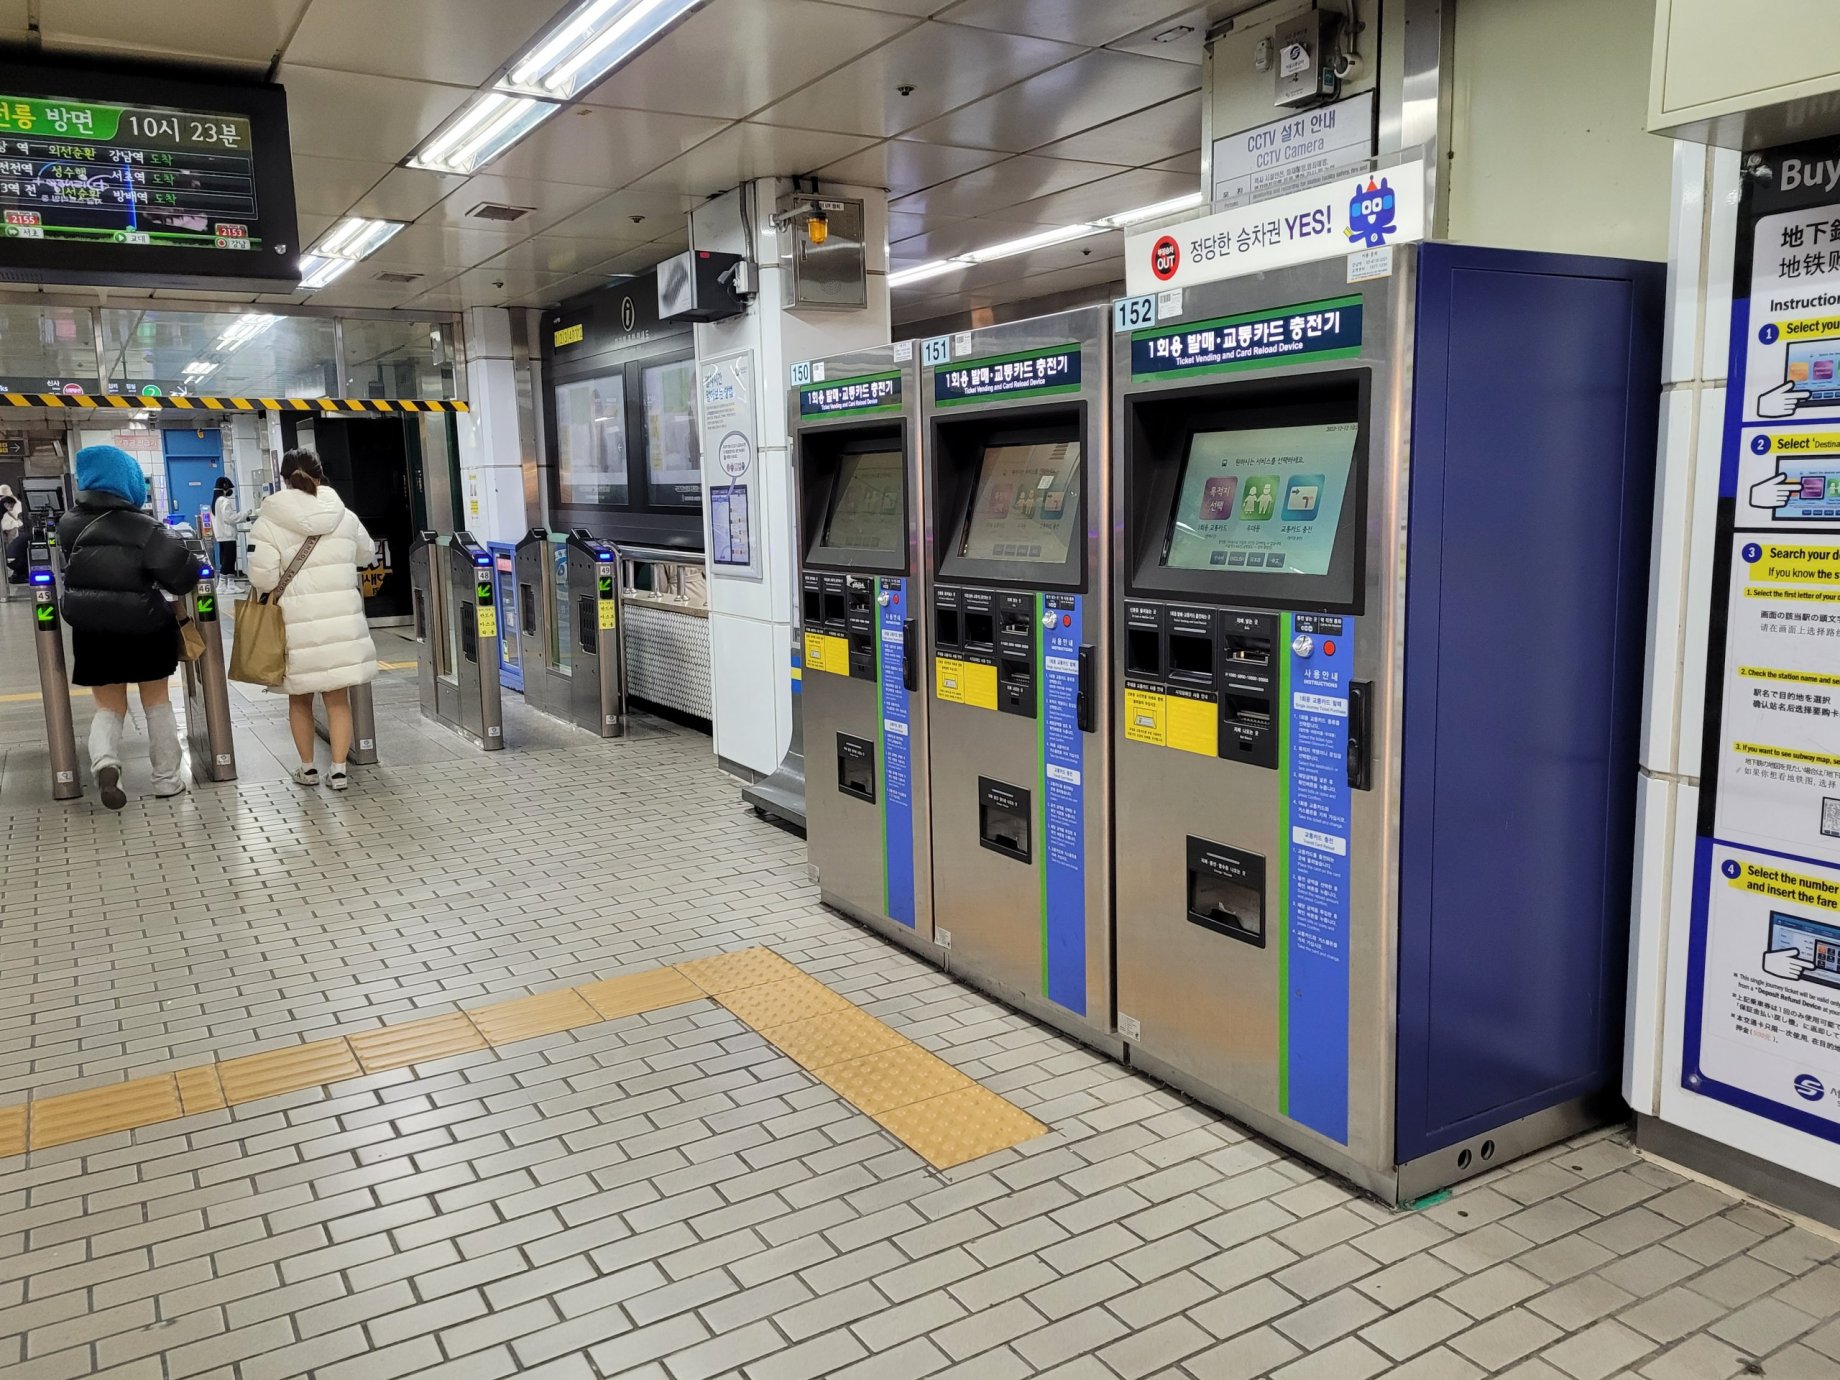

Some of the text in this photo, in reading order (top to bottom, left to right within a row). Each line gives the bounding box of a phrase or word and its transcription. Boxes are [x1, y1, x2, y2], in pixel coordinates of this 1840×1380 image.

[45, 107, 95, 135] 방면
[128, 116, 181, 142] 10시
[190, 122, 242, 148] 23분
[1248, 109, 1336, 153] CCTV 설치 안내
[16, 142, 29, 155] 역
[109, 149, 144, 164] 강남역
[150, 153, 174, 166] 도착
[1256, 137, 1325, 168] CCTV Camera
[152, 172, 176, 185] 도착
[154, 192, 177, 206] 도착
[12, 215, 36, 225] 2155
[1190, 204, 1333, 263] 정당한 승차권 YES!
[1157, 255, 1175, 270] OUT
[1119, 298, 1152, 327] 152
[1148, 337, 1183, 358] 1회용
[1289, 310, 1341, 340] 충전기
[1765, 328, 1773, 340] 1
[1786, 320, 1820, 334] Select
[926, 339, 947, 362] 151
[1176, 341, 1304, 366] Ticket Vending and Card Reload Device
[792, 364, 809, 382] 150
[945, 371, 969, 388] 1회용
[1036, 355, 1068, 377] 충전기
[870, 380, 893, 398] 충전기
[1014, 380, 1030, 389] Reload
[1030, 378, 1046, 387] Device
[1757, 439, 1765, 450] 2
[1777, 438, 1810, 449] Select
[1210, 500, 1224, 512] 선택
[1748, 547, 1756, 558] 3
[1770, 547, 1830, 563] Search your
[479, 571, 489, 580] 48
[601, 566, 610, 575] 49
[1768, 567, 1832, 580] If you know the
[38, 592, 50, 600] 45
[199, 584, 211, 593] 46
[1753, 589, 1773, 597] Select
[1773, 590, 1783, 598] the
[1797, 591, 1815, 599] letter
[1822, 594, 1836, 602] your
[1303, 679, 1338, 689] INSTRUCTIONS
[1748, 669, 1766, 678] Check
[1767, 671, 1777, 679] the
[1778, 671, 1799, 681] station
[1800, 674, 1818, 683] name
[1819, 676, 1831, 684] and
[1752, 700, 1840, 718] 确认站名后选择要购卡
[1747, 746, 1757, 754] you
[1758, 747, 1773, 756] want
[1792, 752, 1815, 763] subway
[1816, 756, 1832, 765] map,
[1727, 864, 1735, 875] 4
[1747, 865, 1839, 895] Select the number
[1747, 880, 1838, 910] and insert the fare
[1780, 993, 1801, 1007] Refund
[1802, 999, 1822, 1012] Device
